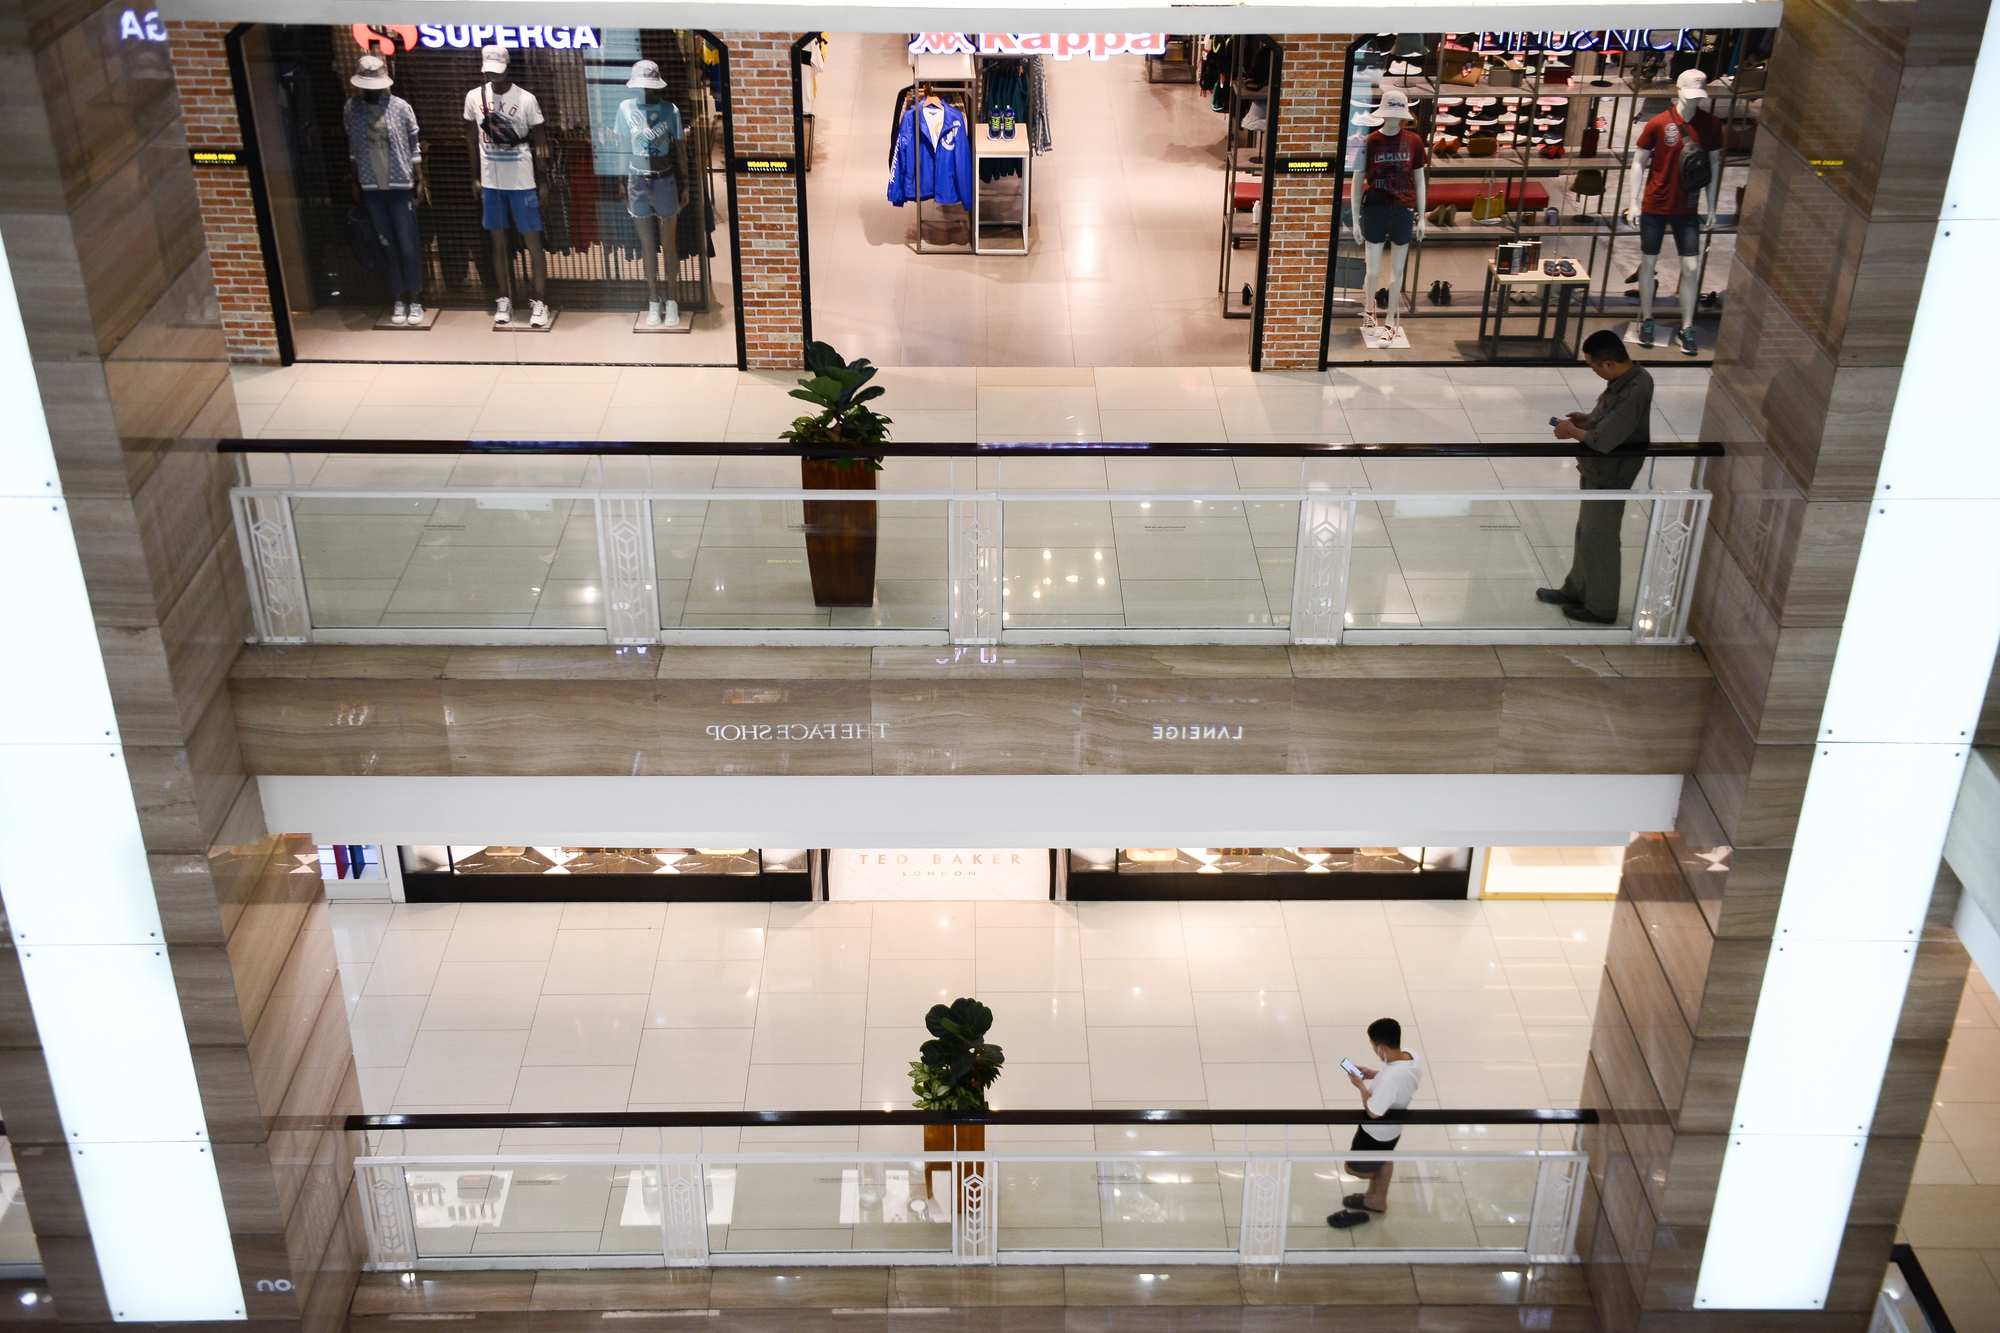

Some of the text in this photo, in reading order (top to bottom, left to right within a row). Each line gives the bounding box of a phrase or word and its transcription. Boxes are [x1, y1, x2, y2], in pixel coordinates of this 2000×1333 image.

[418, 23, 600, 49] SUPERGA
[980, 33, 1165, 59] Kappa
[859, 853, 1021, 865] TED BAKER
